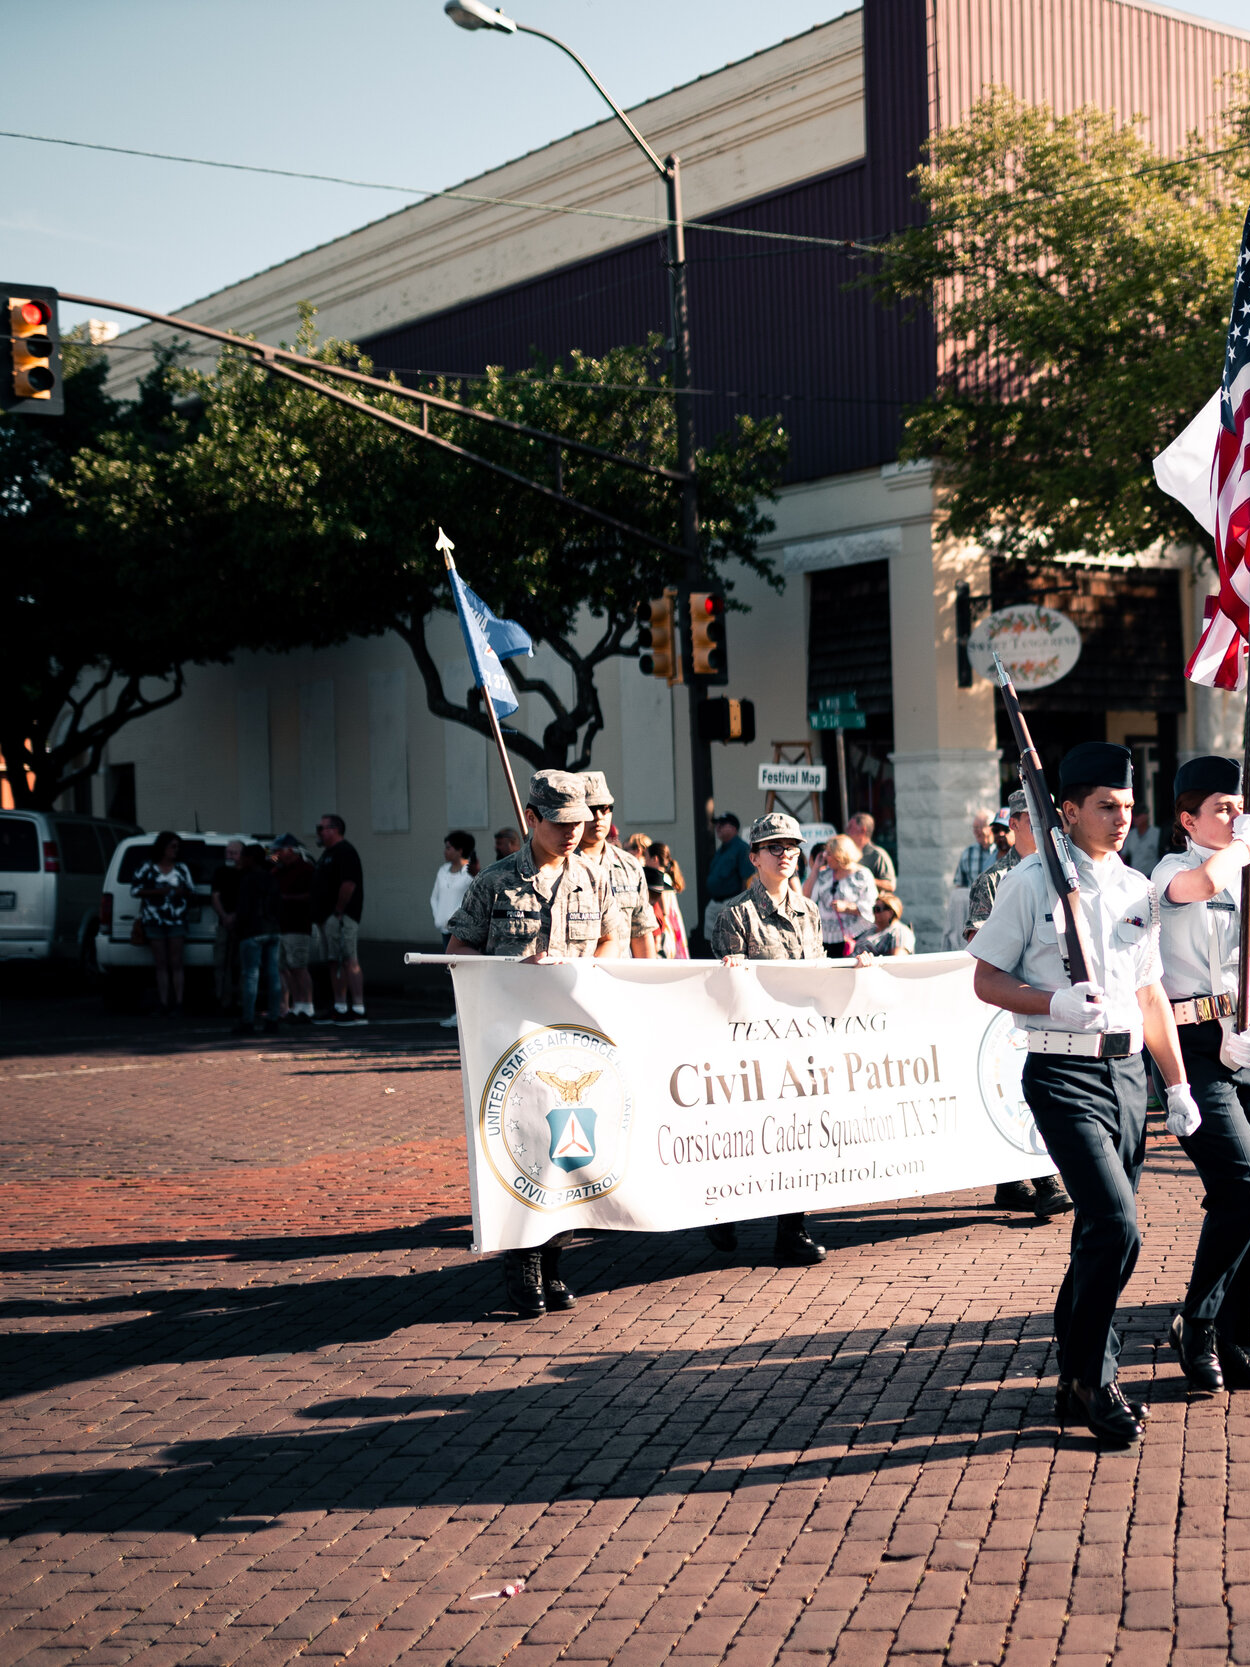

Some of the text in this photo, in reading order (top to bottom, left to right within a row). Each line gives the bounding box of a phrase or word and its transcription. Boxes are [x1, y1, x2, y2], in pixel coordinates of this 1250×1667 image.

[762, 769, 821, 788] Festival Map
[488, 1032, 617, 1136] UNITED STATES AIR FORCE
[669, 1060, 766, 1108] Civil
[777, 1055, 834, 1099] Air
[843, 1044, 941, 1092] Patrol
[657, 1096, 957, 1166] Corsicana Cadet Squadron TX 377
[513, 1176, 547, 1205] CIVIL
[565, 1172, 620, 1201] PATROL
[704, 1158, 925, 1206] gocivilairpatrol.com
